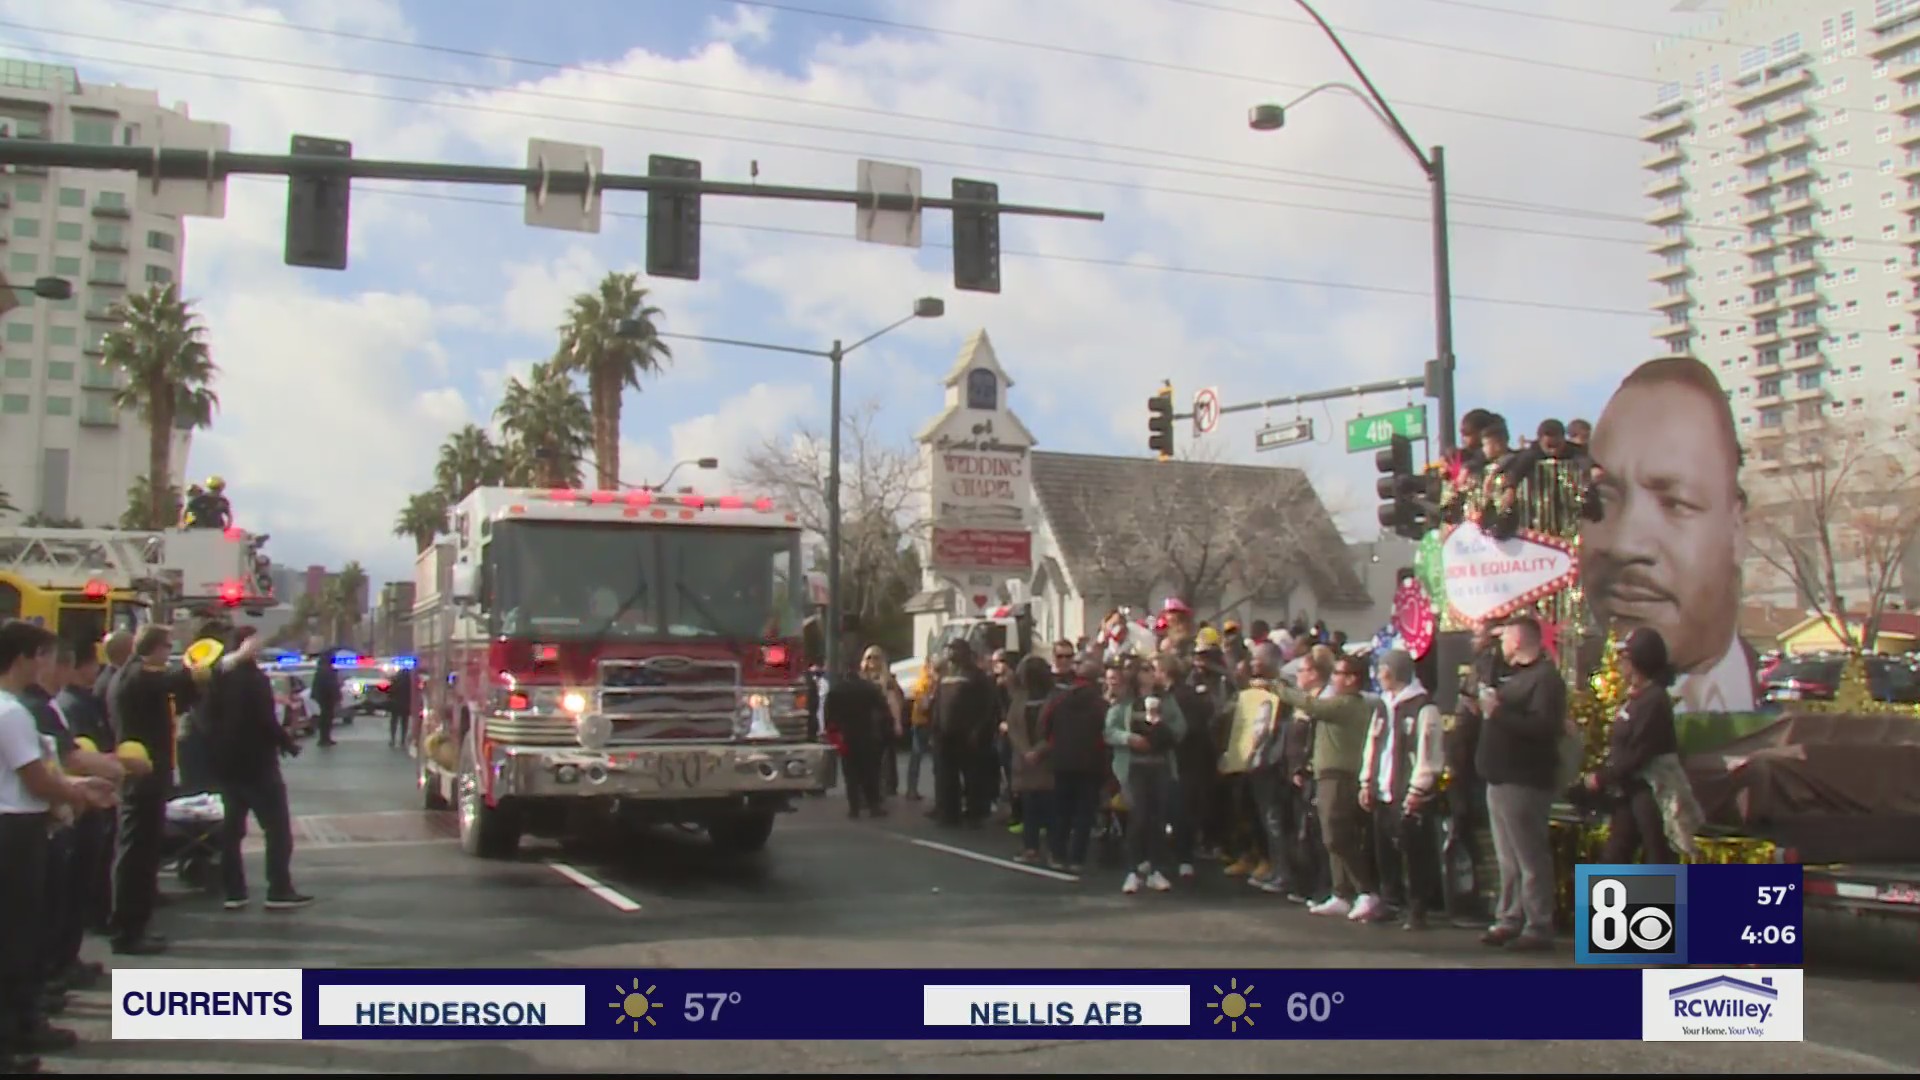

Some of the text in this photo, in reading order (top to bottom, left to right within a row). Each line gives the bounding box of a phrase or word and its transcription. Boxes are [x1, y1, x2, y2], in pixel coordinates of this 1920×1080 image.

[1366, 419, 1392, 443] 4th
[943, 455, 1023, 478] WEDDING
[951, 478, 1015, 500] CHAPEL
[1481, 556, 1557, 577] EQUALITY
